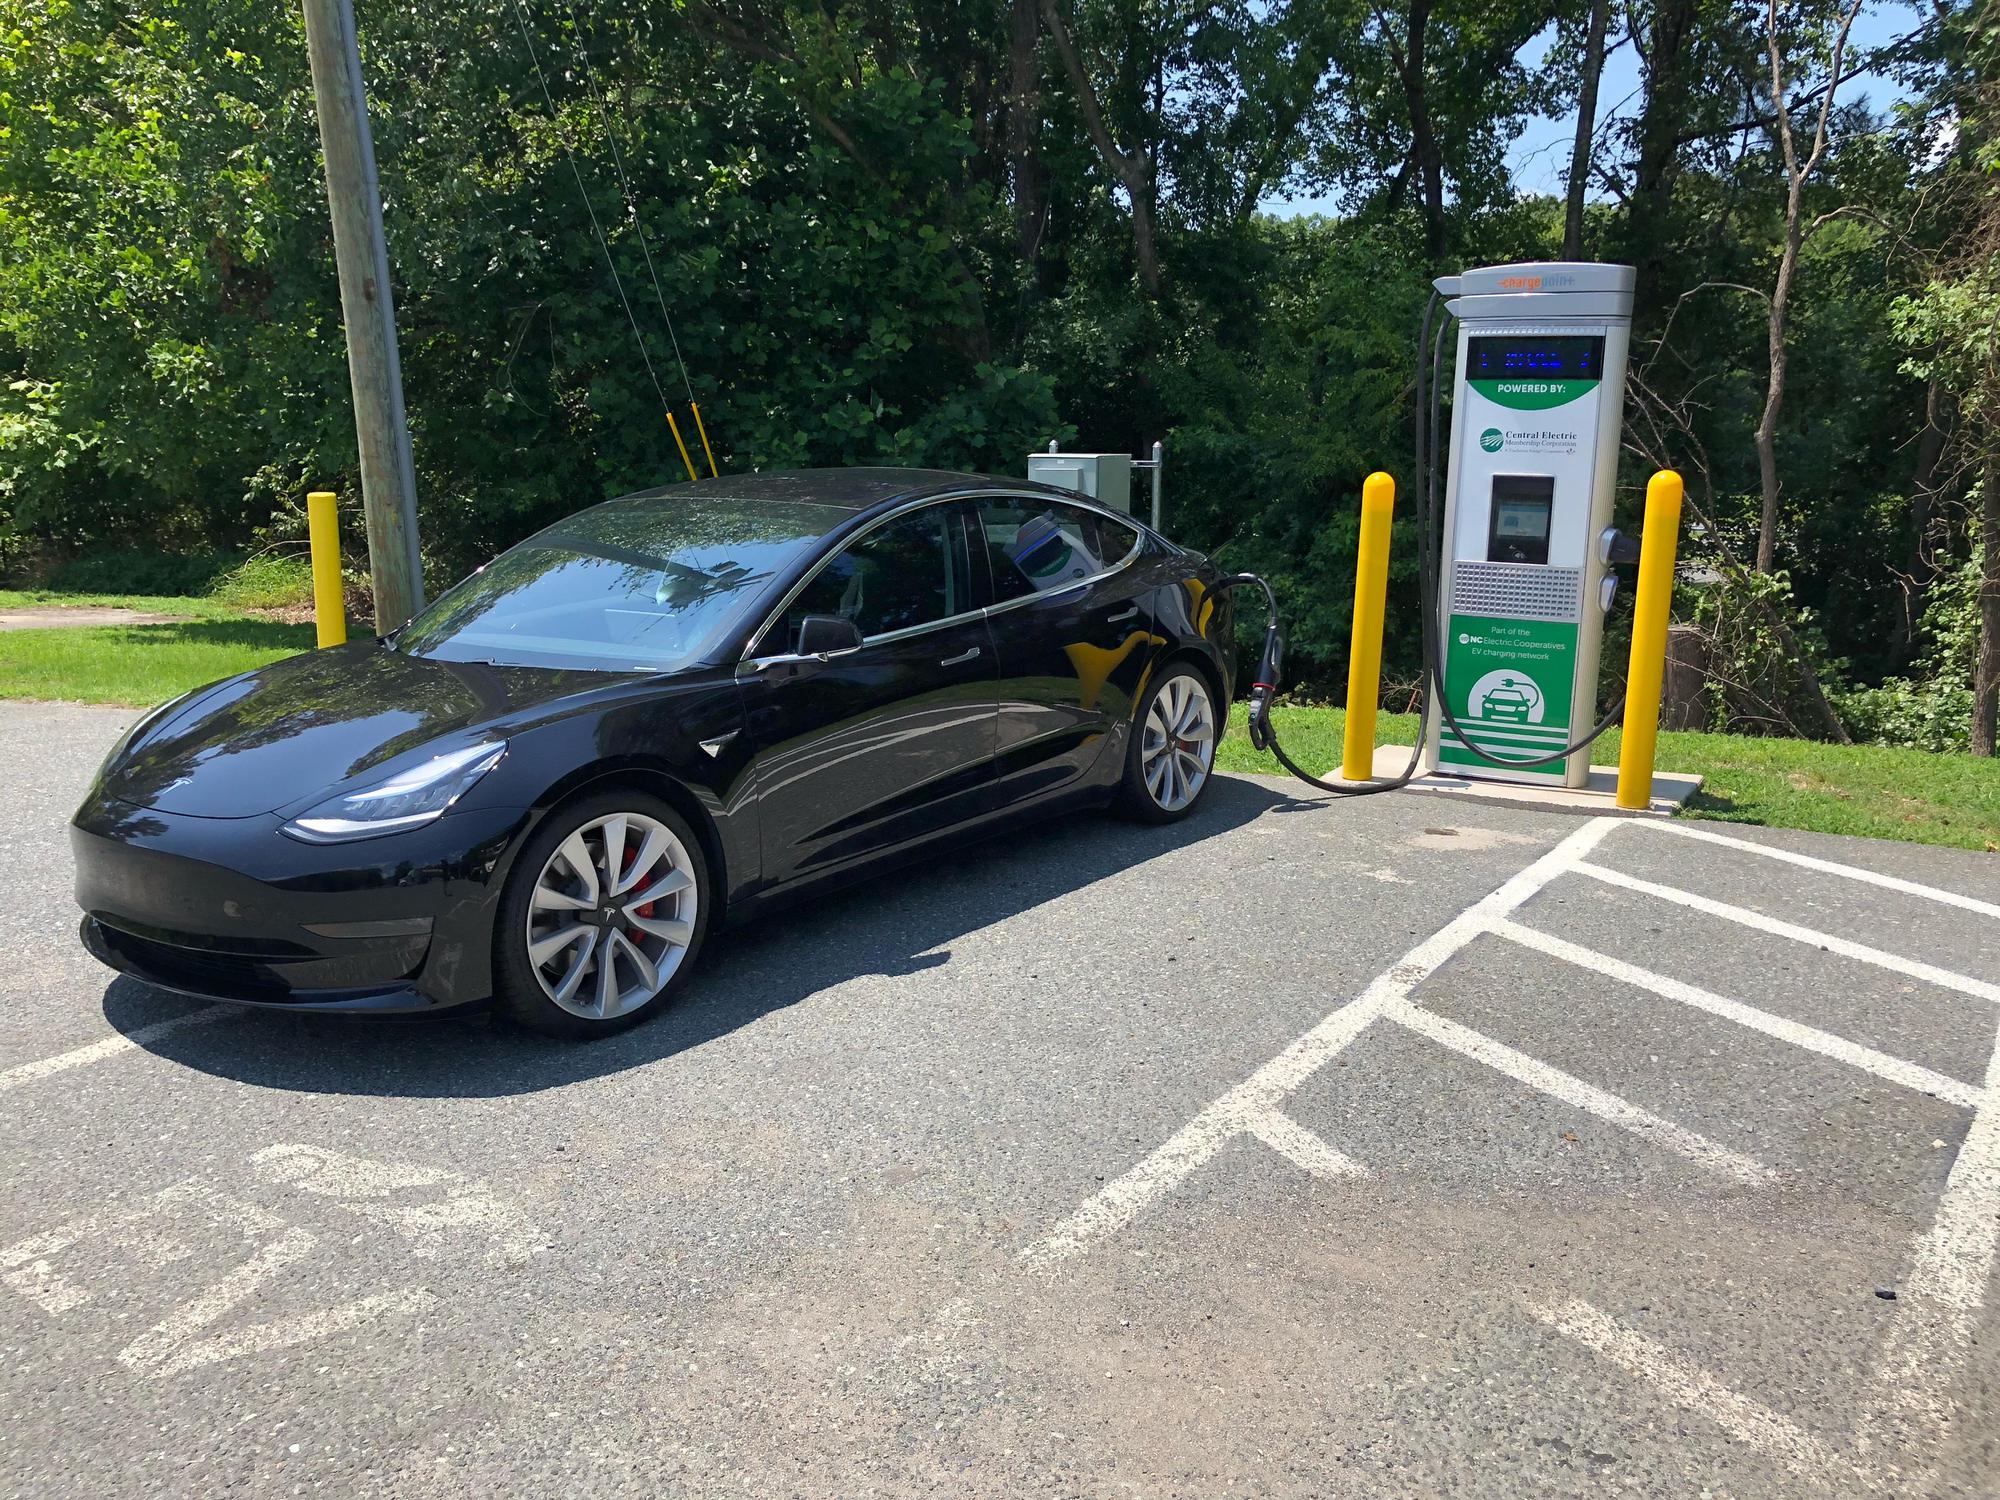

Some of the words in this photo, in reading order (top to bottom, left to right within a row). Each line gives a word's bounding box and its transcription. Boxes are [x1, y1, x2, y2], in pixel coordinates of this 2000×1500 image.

[1497, 384, 1548, 393] POWERED
[1550, 385, 1566, 393] BY:
[1505, 431, 1539, 439] Central
[1542, 432, 1577, 440] Electric
[1491, 626, 1506, 634] Part
[1470, 635, 1483, 644] NC
[1484, 637, 1512, 646] Electric
[1514, 640, 1565, 650] Cooperatives
[1483, 649, 1516, 658] charging
[1517, 652, 1549, 660] network
